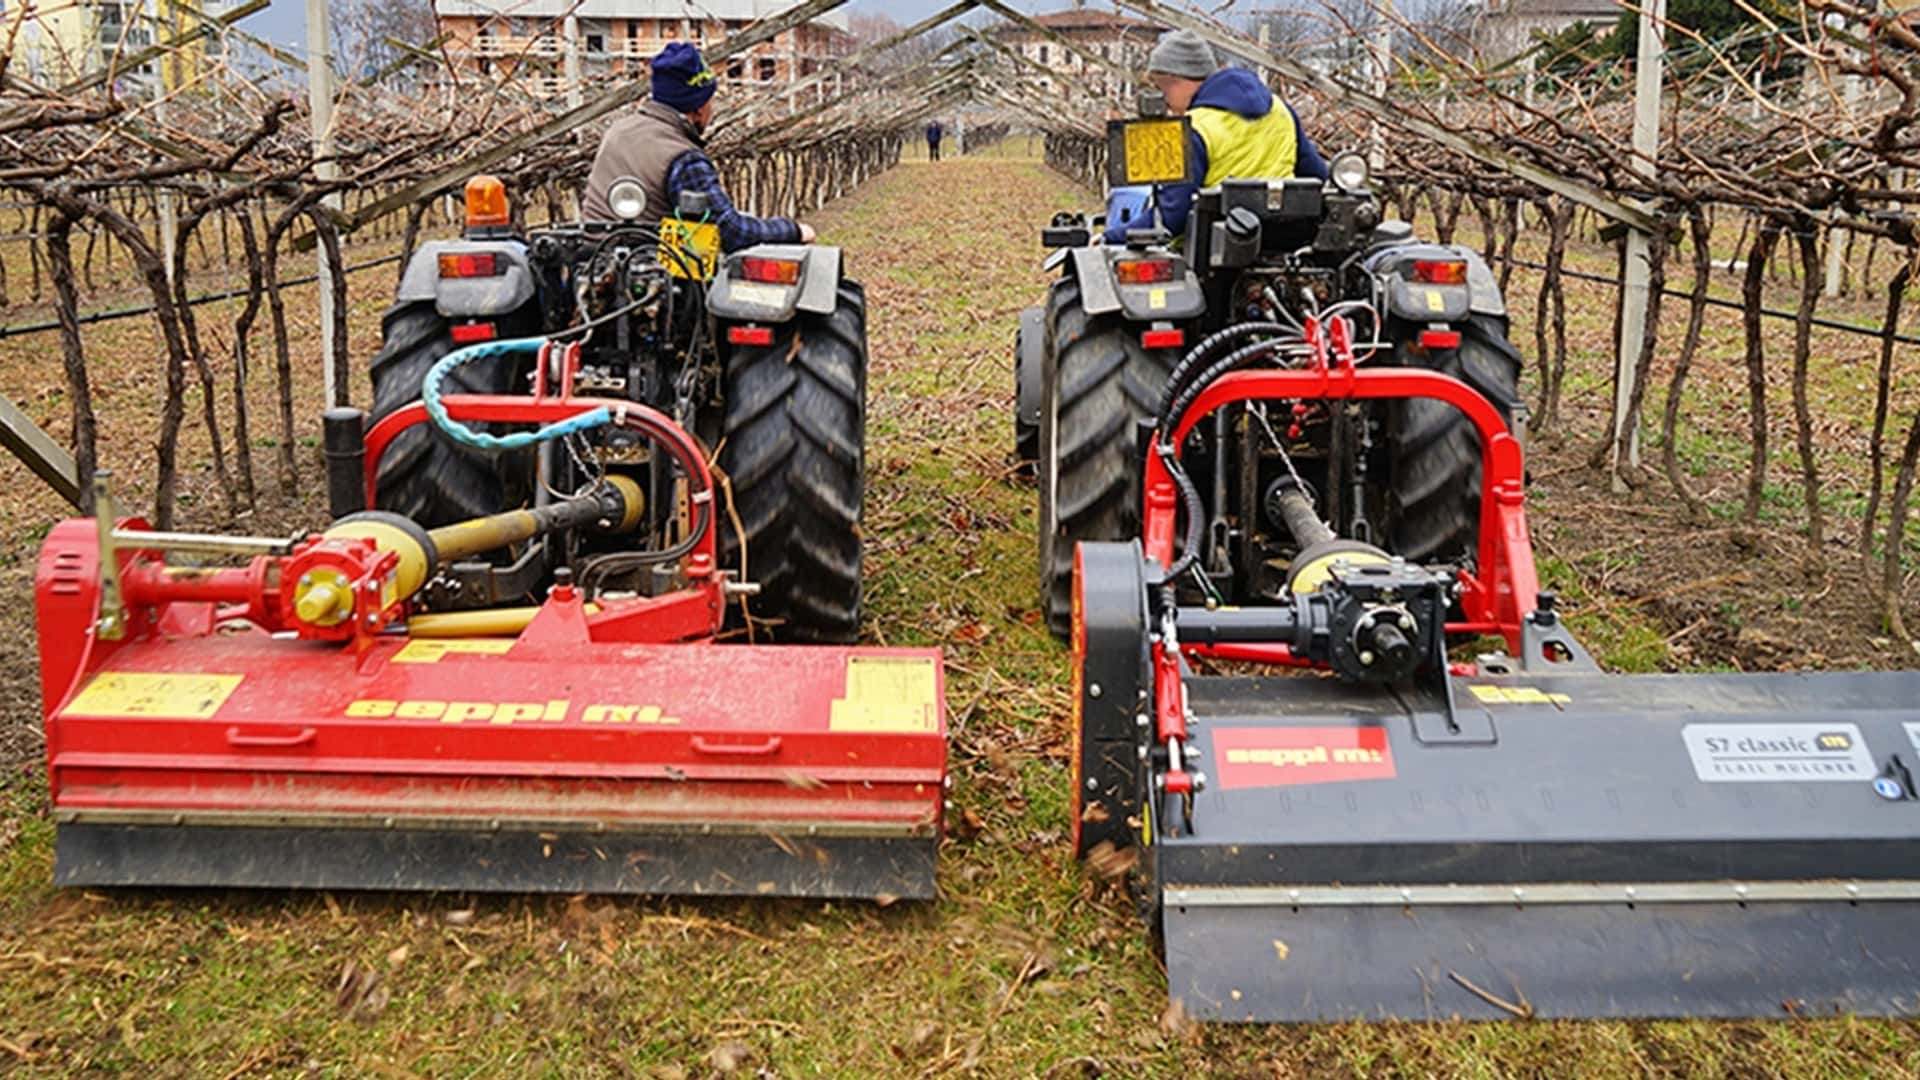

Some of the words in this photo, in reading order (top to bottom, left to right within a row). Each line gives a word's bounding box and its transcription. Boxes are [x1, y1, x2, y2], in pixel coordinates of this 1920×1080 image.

[343, 699, 570, 724] seppi
[1704, 736, 1729, 753] S7
[1736, 736, 1809, 753] classic
[1226, 746, 1328, 766] seppi
